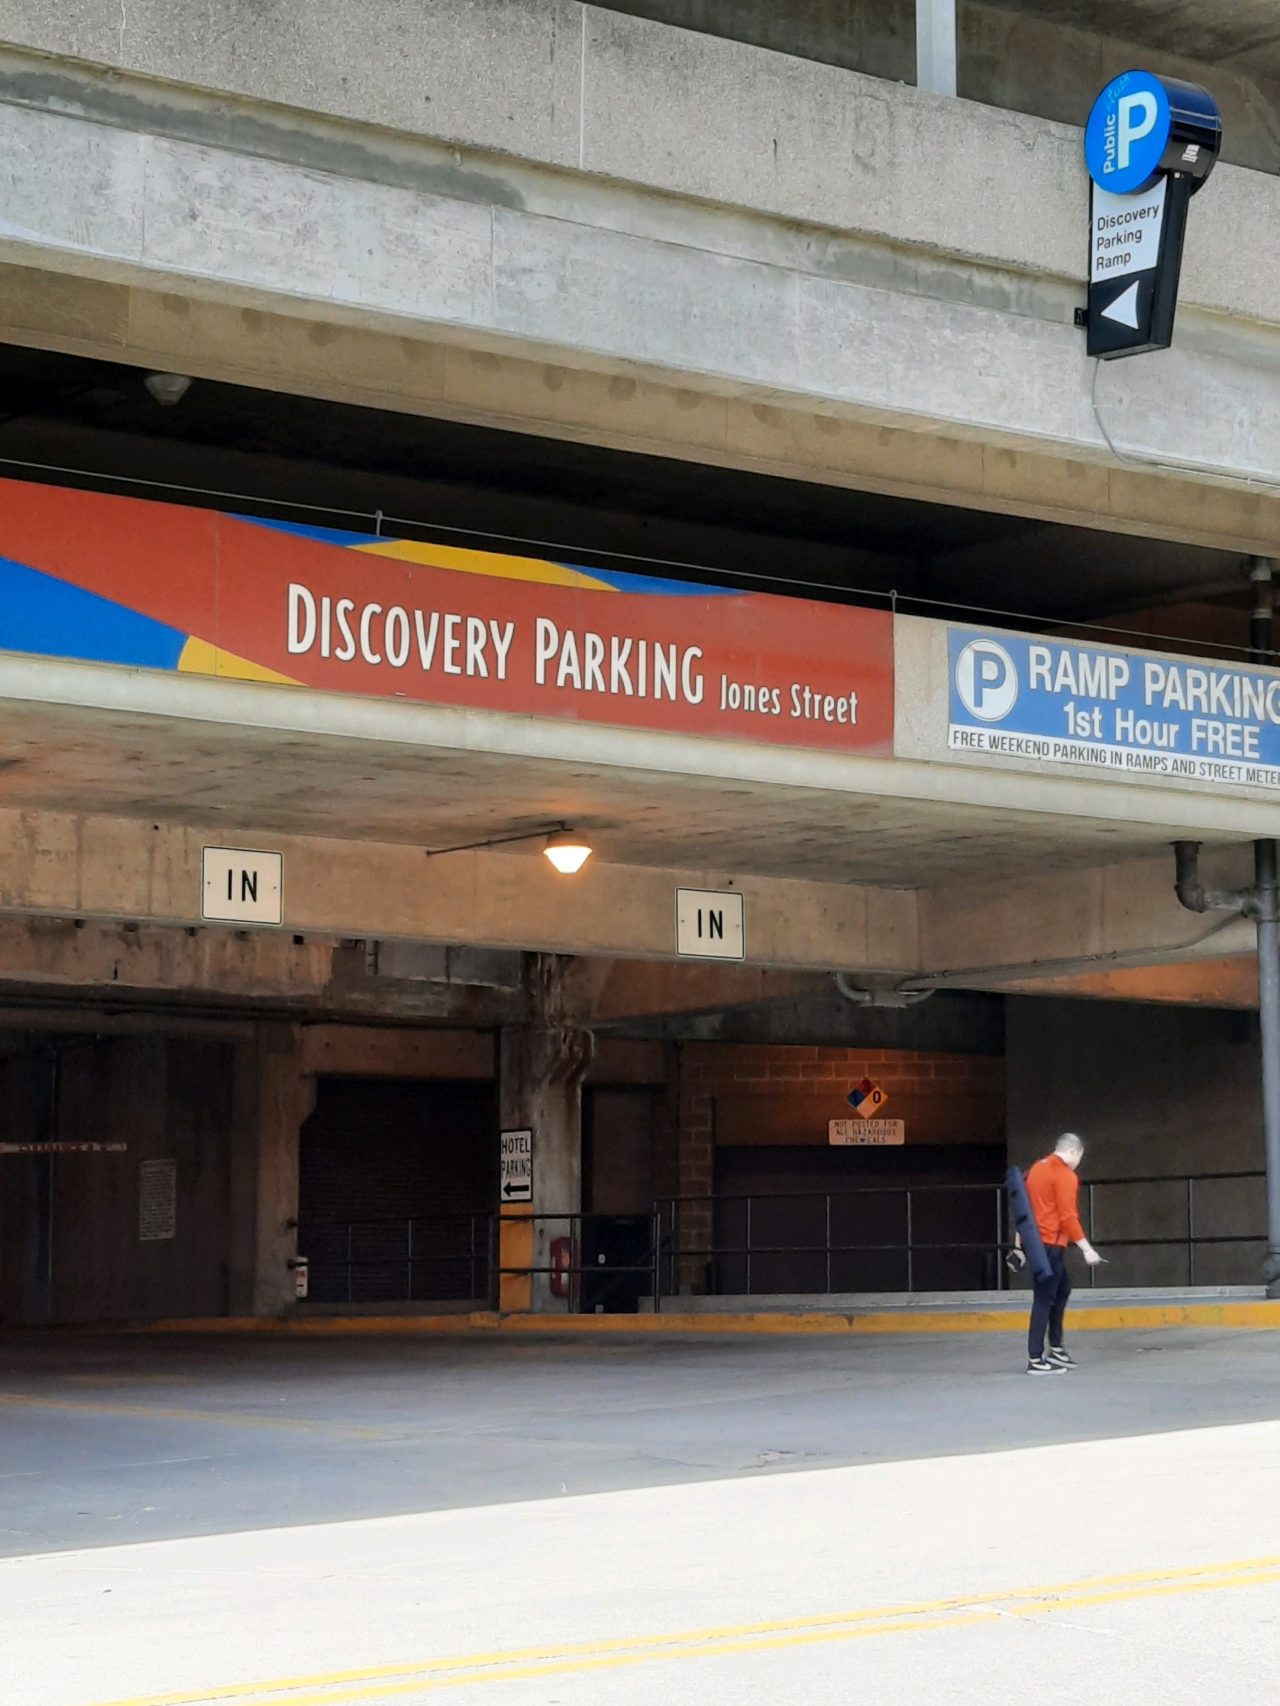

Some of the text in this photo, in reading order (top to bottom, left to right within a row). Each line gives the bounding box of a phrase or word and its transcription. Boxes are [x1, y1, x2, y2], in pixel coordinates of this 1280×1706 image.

[1103, 113, 1116, 175] Public
[1117, 90, 1158, 170] P
[1097, 204, 1160, 231] Discovery
[1096, 228, 1143, 251] Parking
[1096, 251, 1132, 271] Ramp
[287, 583, 859, 725] DISCOVERY PARKING Jones Street
[973, 649, 1007, 709] P
[1028, 645, 1280, 725] RAMP PARKING
[1063, 701, 1261, 760] 1st Hour FREE
[953, 730, 985, 749] FREE
[988, 734, 1050, 757] WEEKEND
[1053, 743, 1107, 764] PARKING
[1110, 748, 1123, 766] IN
[1126, 753, 1168, 772] RAMPS
[1171, 760, 1196, 775] AND
[1199, 763, 1242, 781] STREET
[227, 869, 258, 903] IN
[697, 908, 723, 939] IN
[501, 1137, 530, 1154] HOTEL
[501, 1158, 531, 1179] PARKING
